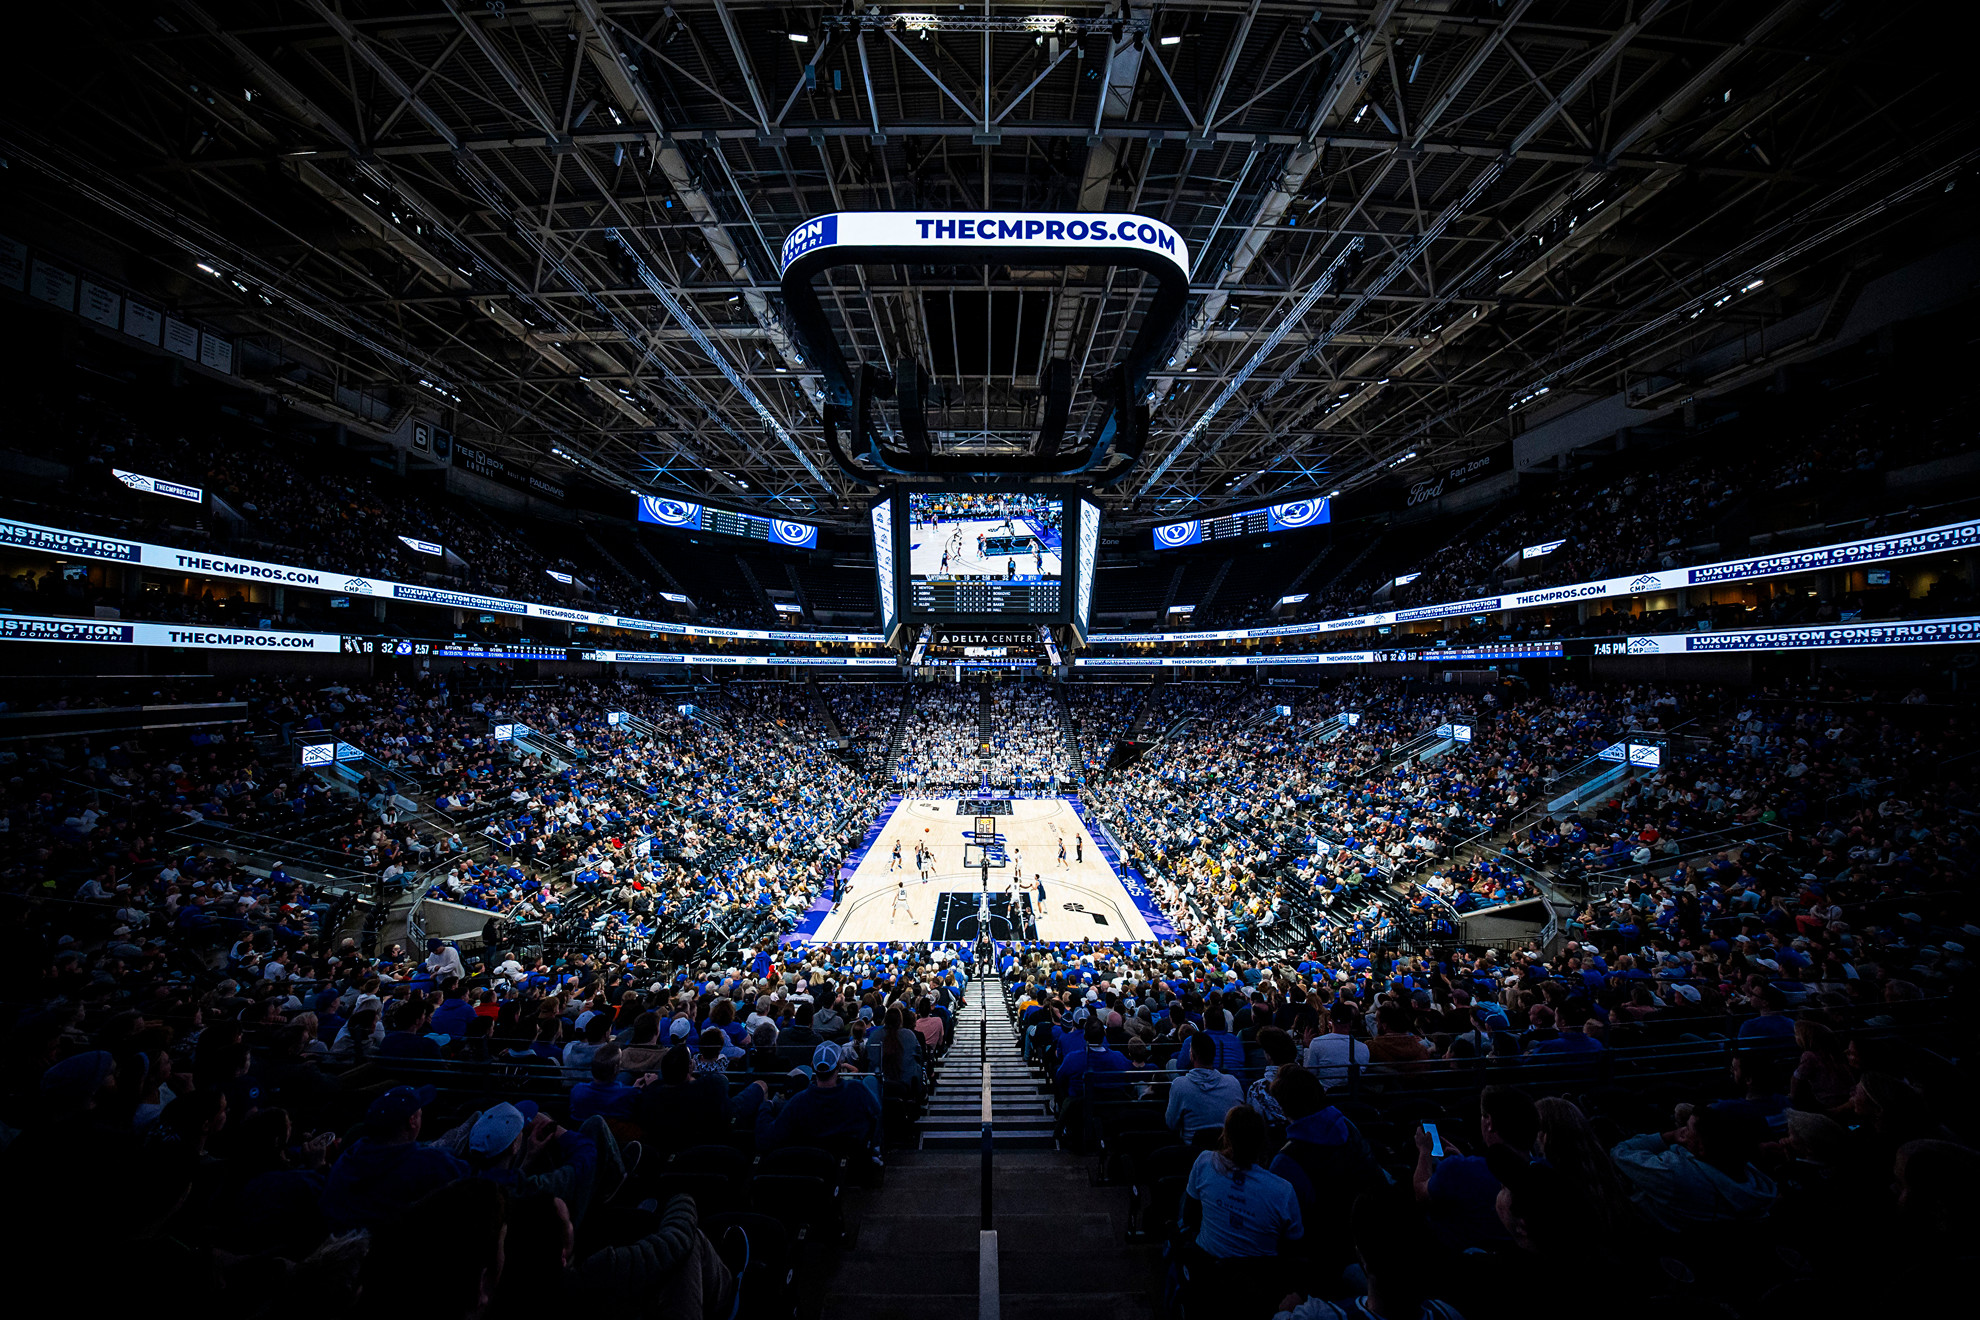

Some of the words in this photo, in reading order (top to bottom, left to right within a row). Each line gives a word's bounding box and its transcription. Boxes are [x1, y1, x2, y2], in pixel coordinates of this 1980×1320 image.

[783, 221, 822, 257] TION
[915, 219, 1176, 256] THECMPROS.COM
[788, 236, 823, 260] OVER!
[415, 427, 427, 446] 6
[455, 443, 475, 458] TEE
[487, 457, 504, 470] BOX
[1450, 466, 1466, 480] Fan
[1468, 456, 1490, 474] Zone
[1407, 476, 1445, 507] Ford
[175, 554, 320, 585] THECMPROS.COM
[1695, 562, 1754, 578] LUXURY
[1757, 551, 1829, 569] CUSTOM
[344, 585, 360, 593] CMP
[398, 587, 435, 598] LUXURY
[436, 592, 470, 602] CUSTOM
[471, 597, 524, 610] CONSTRUCTION
[1516, 585, 1607, 604] THECMPROS.COM
[1629, 585, 1646, 593] CMP
[538, 608, 589, 621] THECMPROS.COM
[0, 619, 122, 635] STRUCTION
[168, 631, 314, 648] THECMPROS.COM
[362, 642, 373, 653] 18
[381, 643, 393, 653] 32
[952, 635, 988, 643] DELTA
[991, 635, 1032, 643] CENTER
[1693, 635, 1751, 645] LUXURY
[1754, 631, 1825, 642] CUSTOM
[415, 644, 429, 655] 2:57
[1594, 643, 1611, 655] 7:45
[1612, 642, 1626, 655] PM
